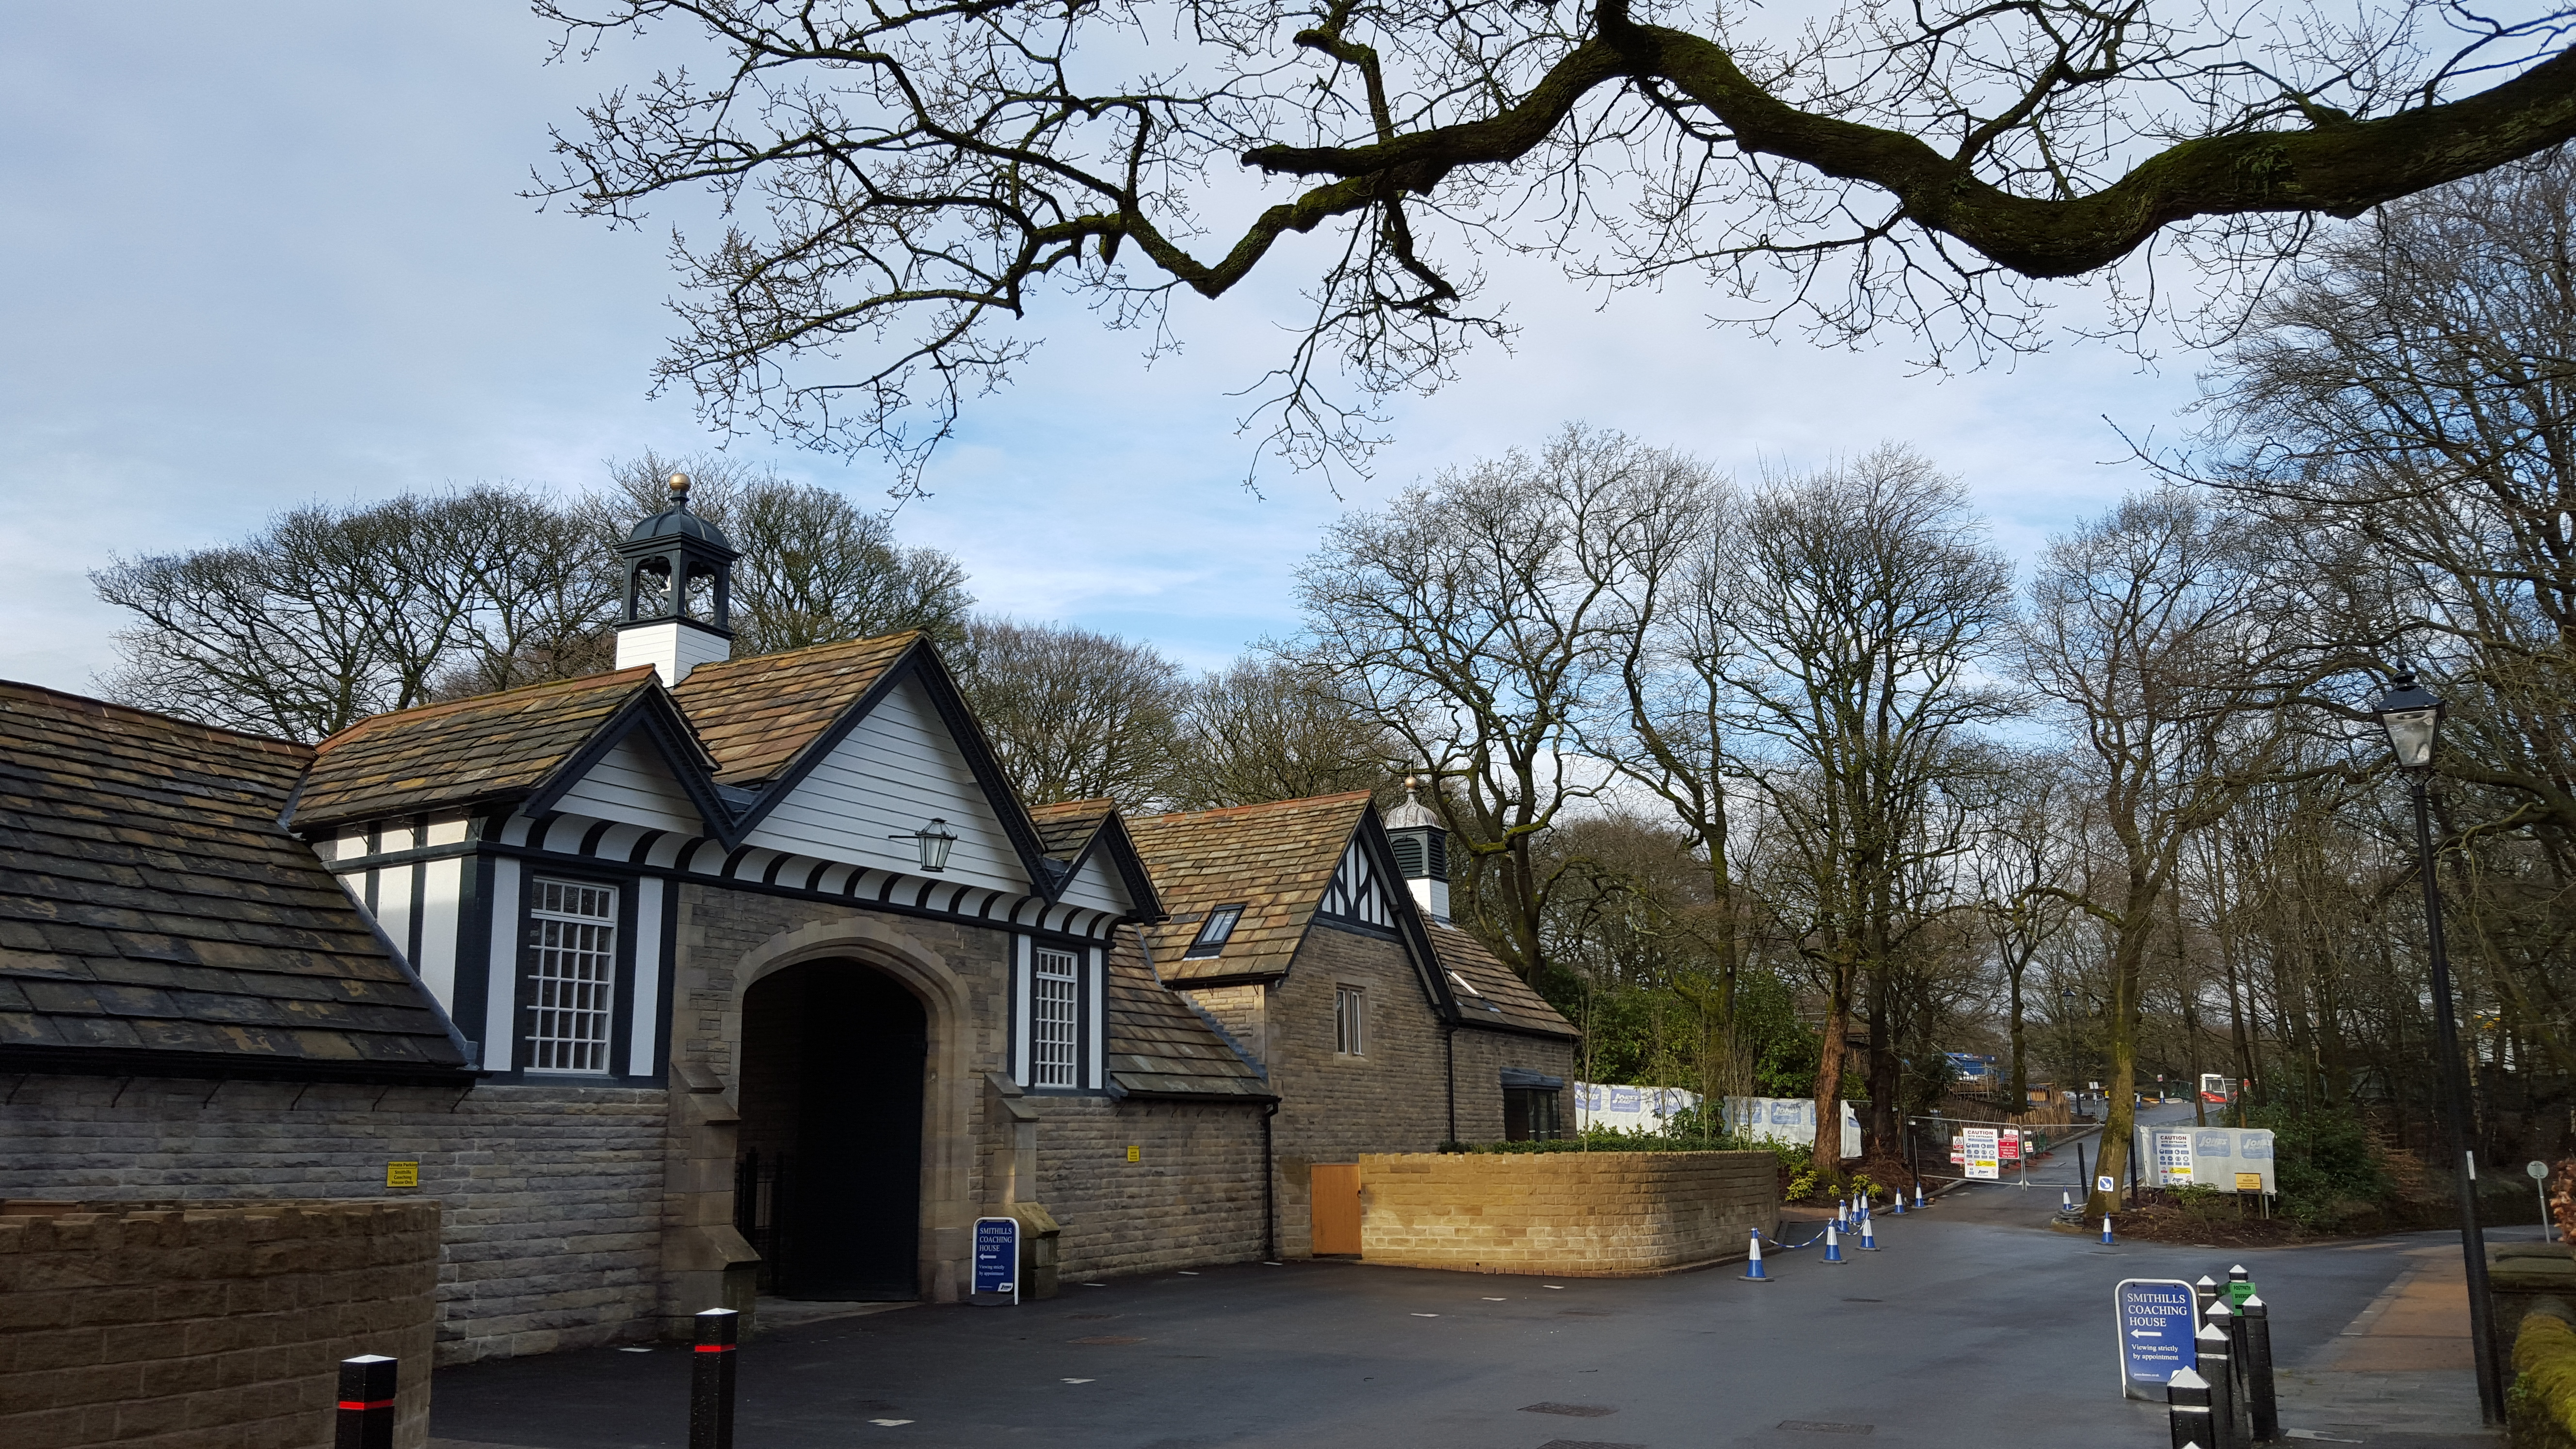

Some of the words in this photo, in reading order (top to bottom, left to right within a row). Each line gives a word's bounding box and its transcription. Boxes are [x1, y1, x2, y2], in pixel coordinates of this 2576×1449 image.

[2199, 1136, 2227, 1146] JONES
[2127, 1293, 2186, 1304] SMITHILLS
[2128, 1305, 2187, 1316] COACHING
[2129, 1317, 2167, 1327] HOUSE
[2131, 1344, 2157, 1352] Viewing
[2157, 1345, 2178, 1353] strictly
